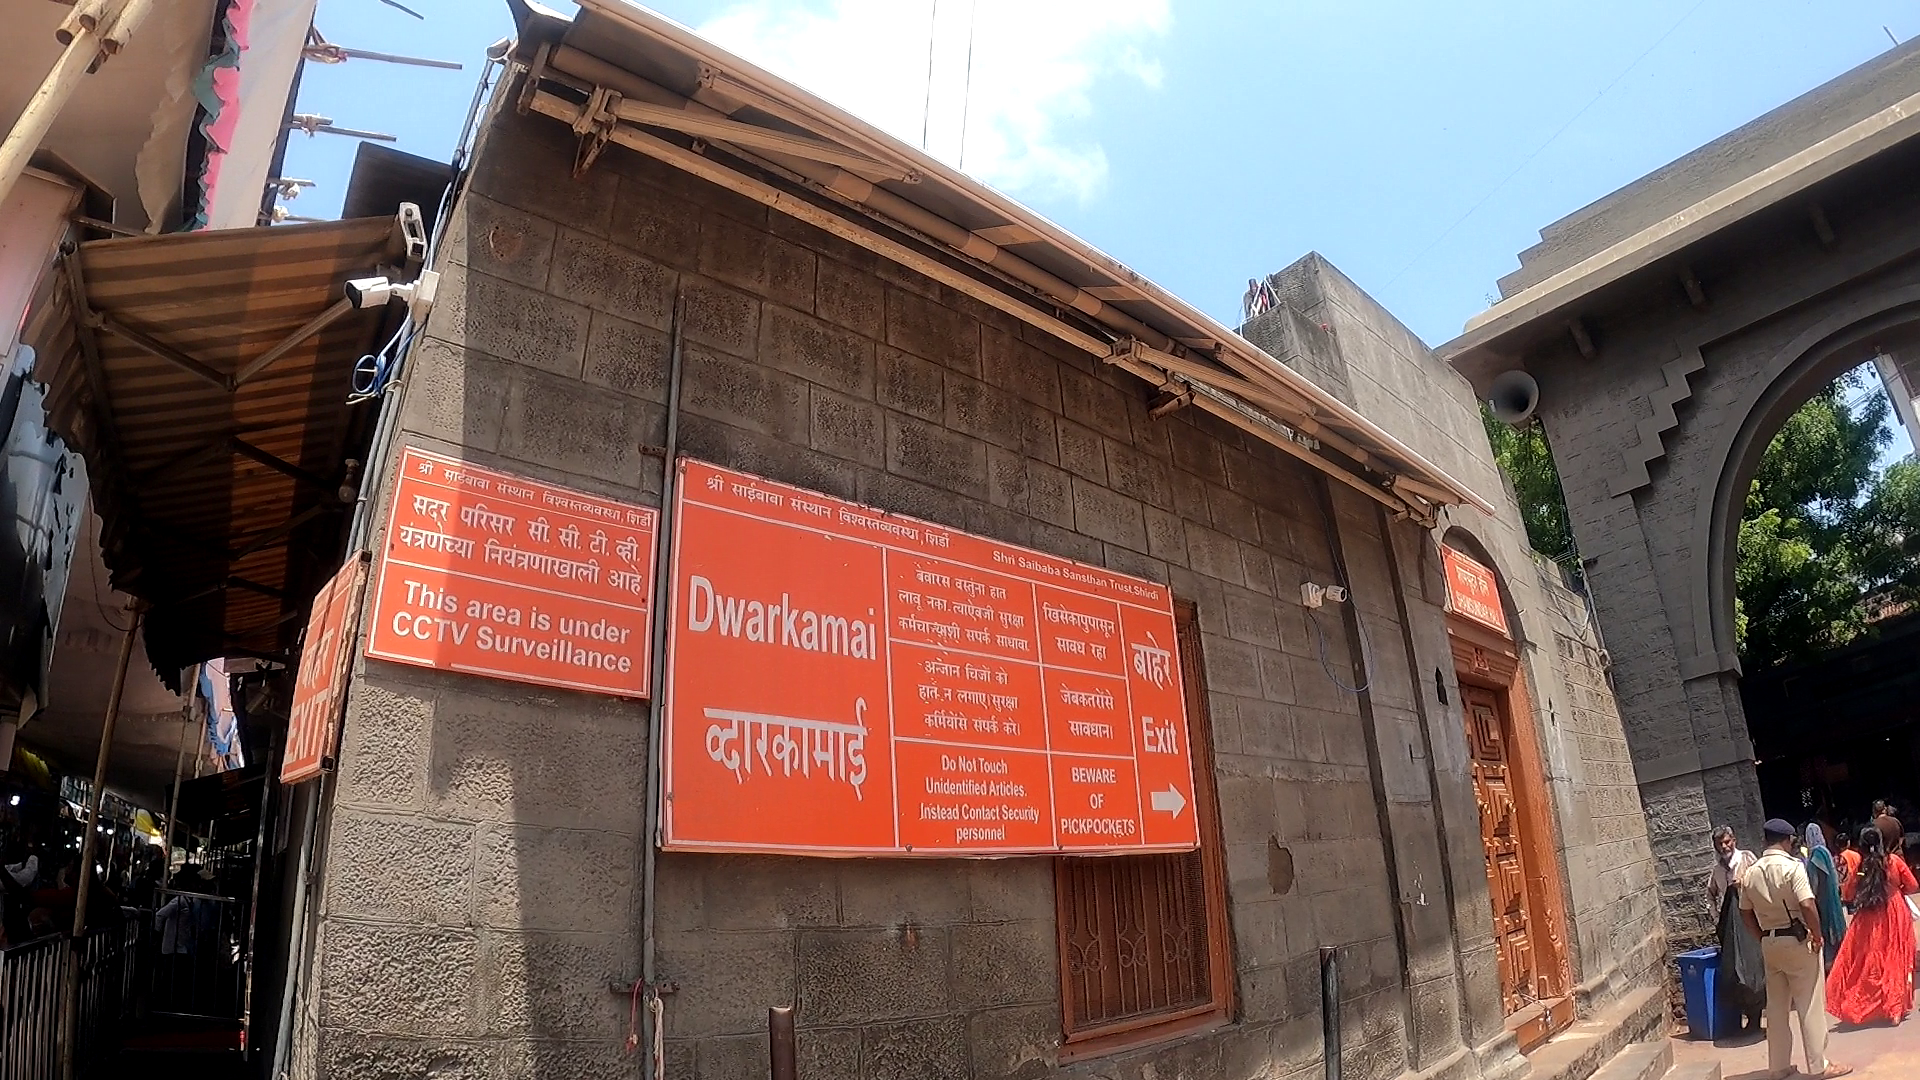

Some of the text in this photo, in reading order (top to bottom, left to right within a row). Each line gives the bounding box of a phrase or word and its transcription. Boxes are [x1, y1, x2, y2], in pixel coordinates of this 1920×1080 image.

[418, 461, 434, 476] श्री
[496, 479, 534, 501] संस्थान
[706, 474, 724, 493] श्री
[731, 482, 784, 507] साईबाबा
[790, 495, 832, 519] संस्थान
[413, 494, 450, 522] सदर
[460, 503, 516, 536] परिसर
[607, 561, 643, 595] आहे
[992, 550, 1016, 565] Shri
[1018, 557, 1061, 577] Saibaba
[1063, 568, 1107, 588] Sansthan
[989, 584, 1007, 600] हात
[404, 579, 630, 644] This area is under
[688, 575, 877, 660] Dwarkamai
[999, 610, 1024, 629] सुरक्षा
[392, 611, 632, 673] CCTV Surveillance
[1054, 636, 1107, 661] सावध रहा
[1131, 630, 1174, 690] बाहेर
[995, 667, 1008, 685] को
[943, 687, 952, 702] न
[284, 687, 330, 766] EXIT
[1141, 715, 1179, 755] Exit
[941, 754, 1008, 775] Do Not Touch
[1071, 767, 1117, 784] BEWARE
[925, 776, 1028, 798] Unidentified Articles.
[920, 802, 1040, 824] Instead Contact Security
[1089, 793, 1105, 810] OF
[956, 824, 1006, 844] personnel
[1061, 818, 1136, 836] PICKPOCKETS
